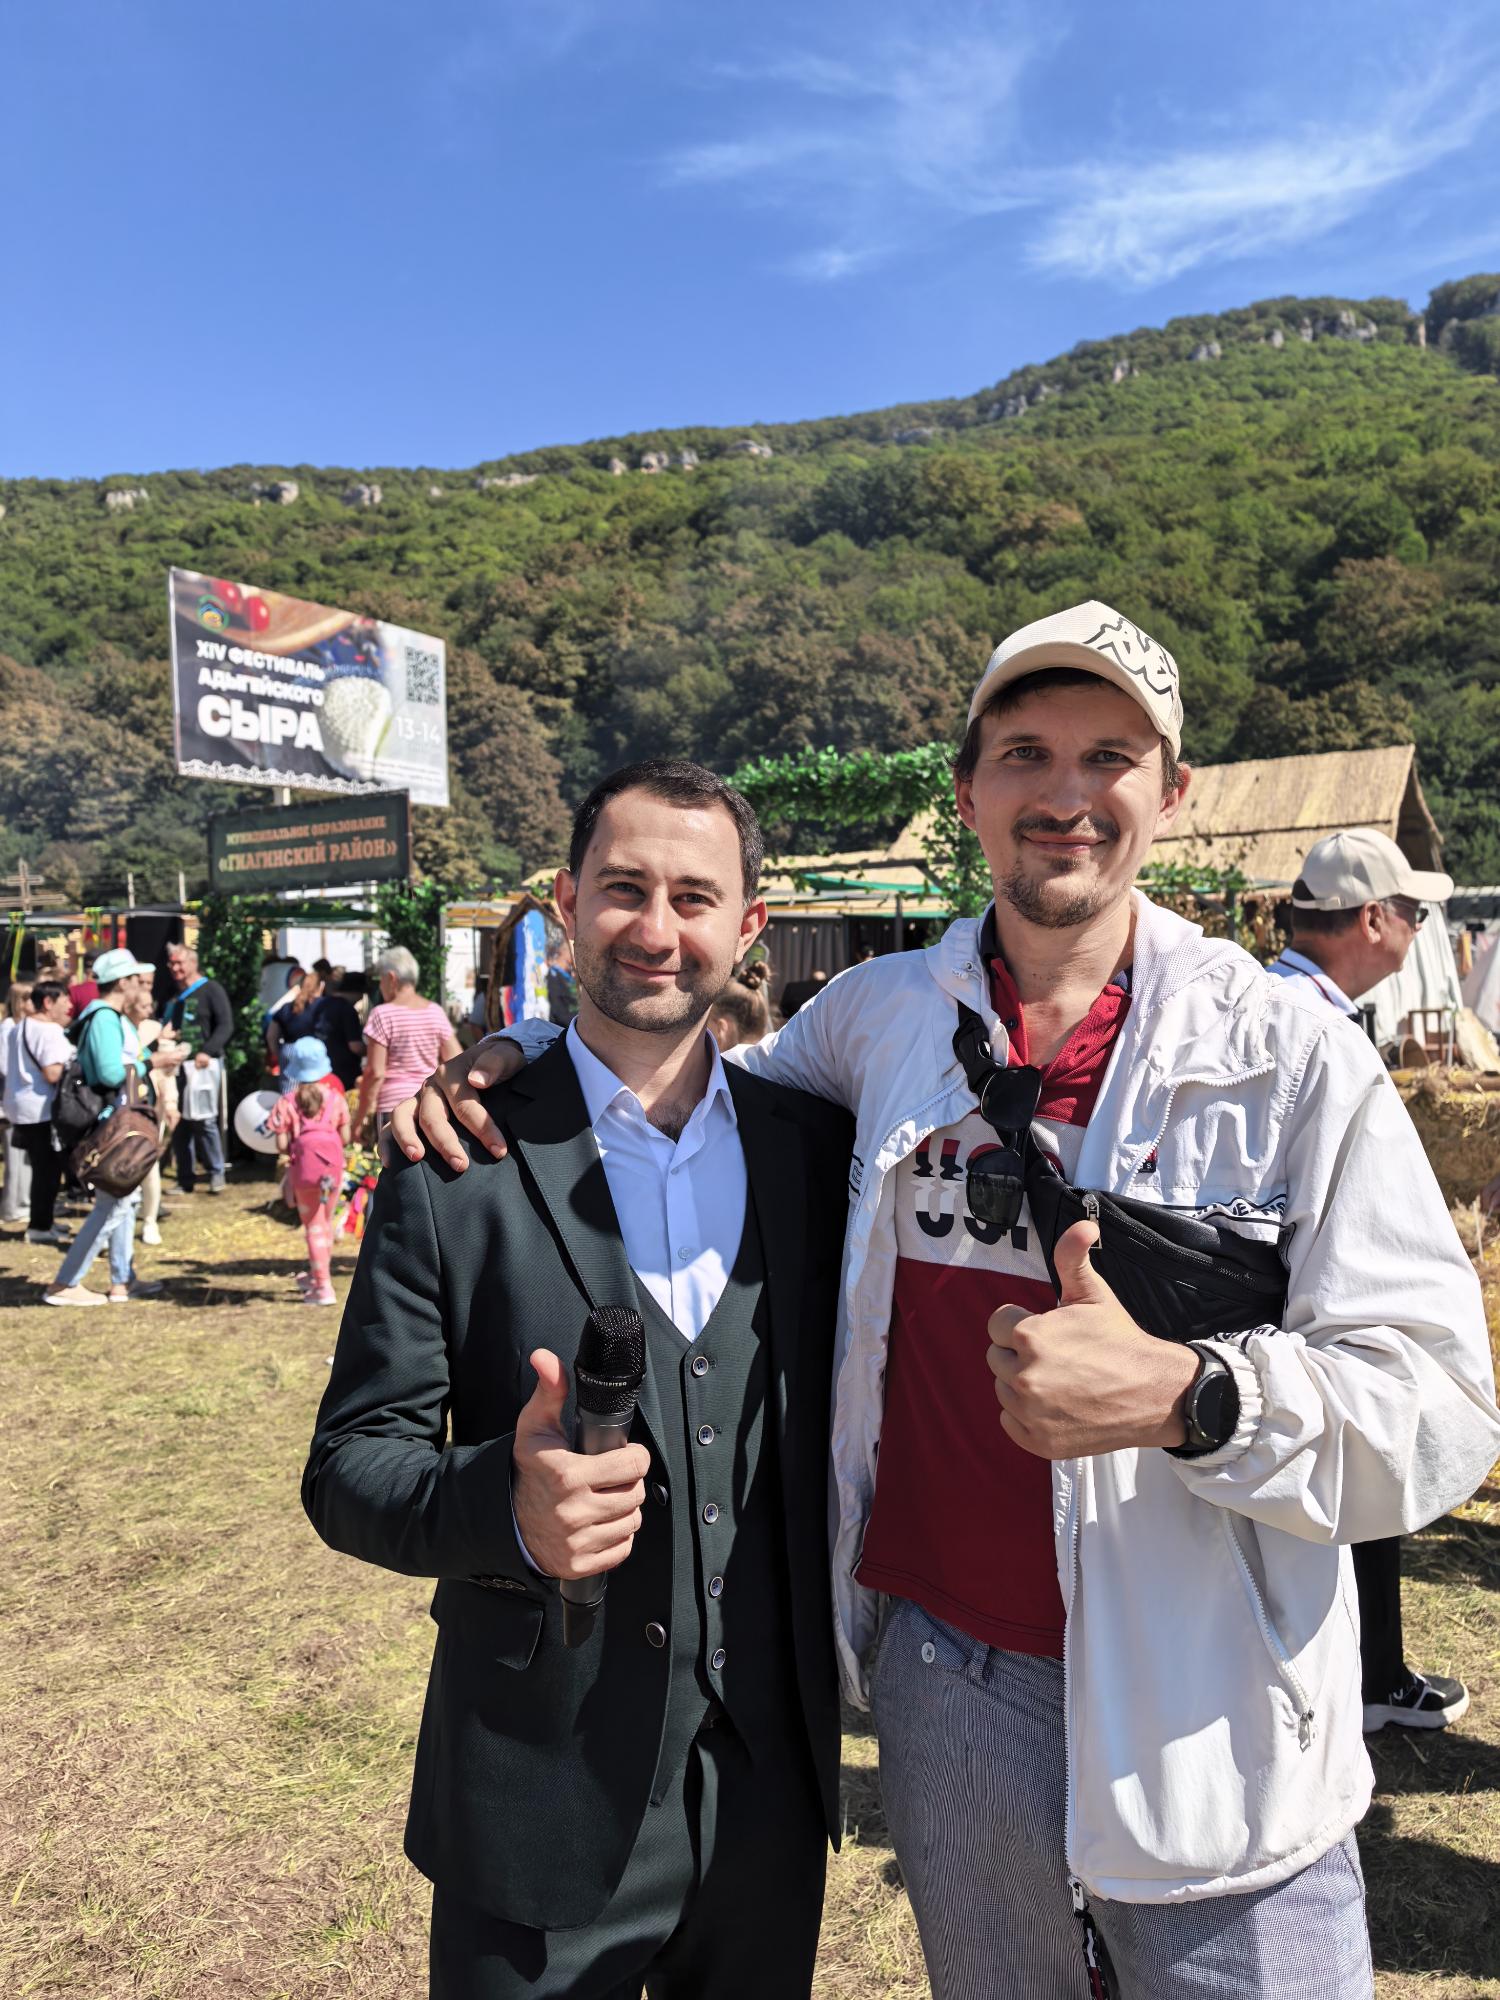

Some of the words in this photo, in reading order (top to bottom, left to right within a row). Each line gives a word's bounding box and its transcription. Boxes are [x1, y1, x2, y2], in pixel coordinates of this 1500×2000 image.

[196, 639, 227, 661] XIV
[228, 646, 326, 682] ФЕСТИВАЛЬ
[197, 667, 325, 706] АДЫГЕЙСКОГО
[197, 694, 325, 752] СЫРА
[395, 715, 442, 745] 13-14
[311, 816, 387, 837] ОБРАЗОВАНИЕ
[329, 836, 398, 863] РАЙОН»
